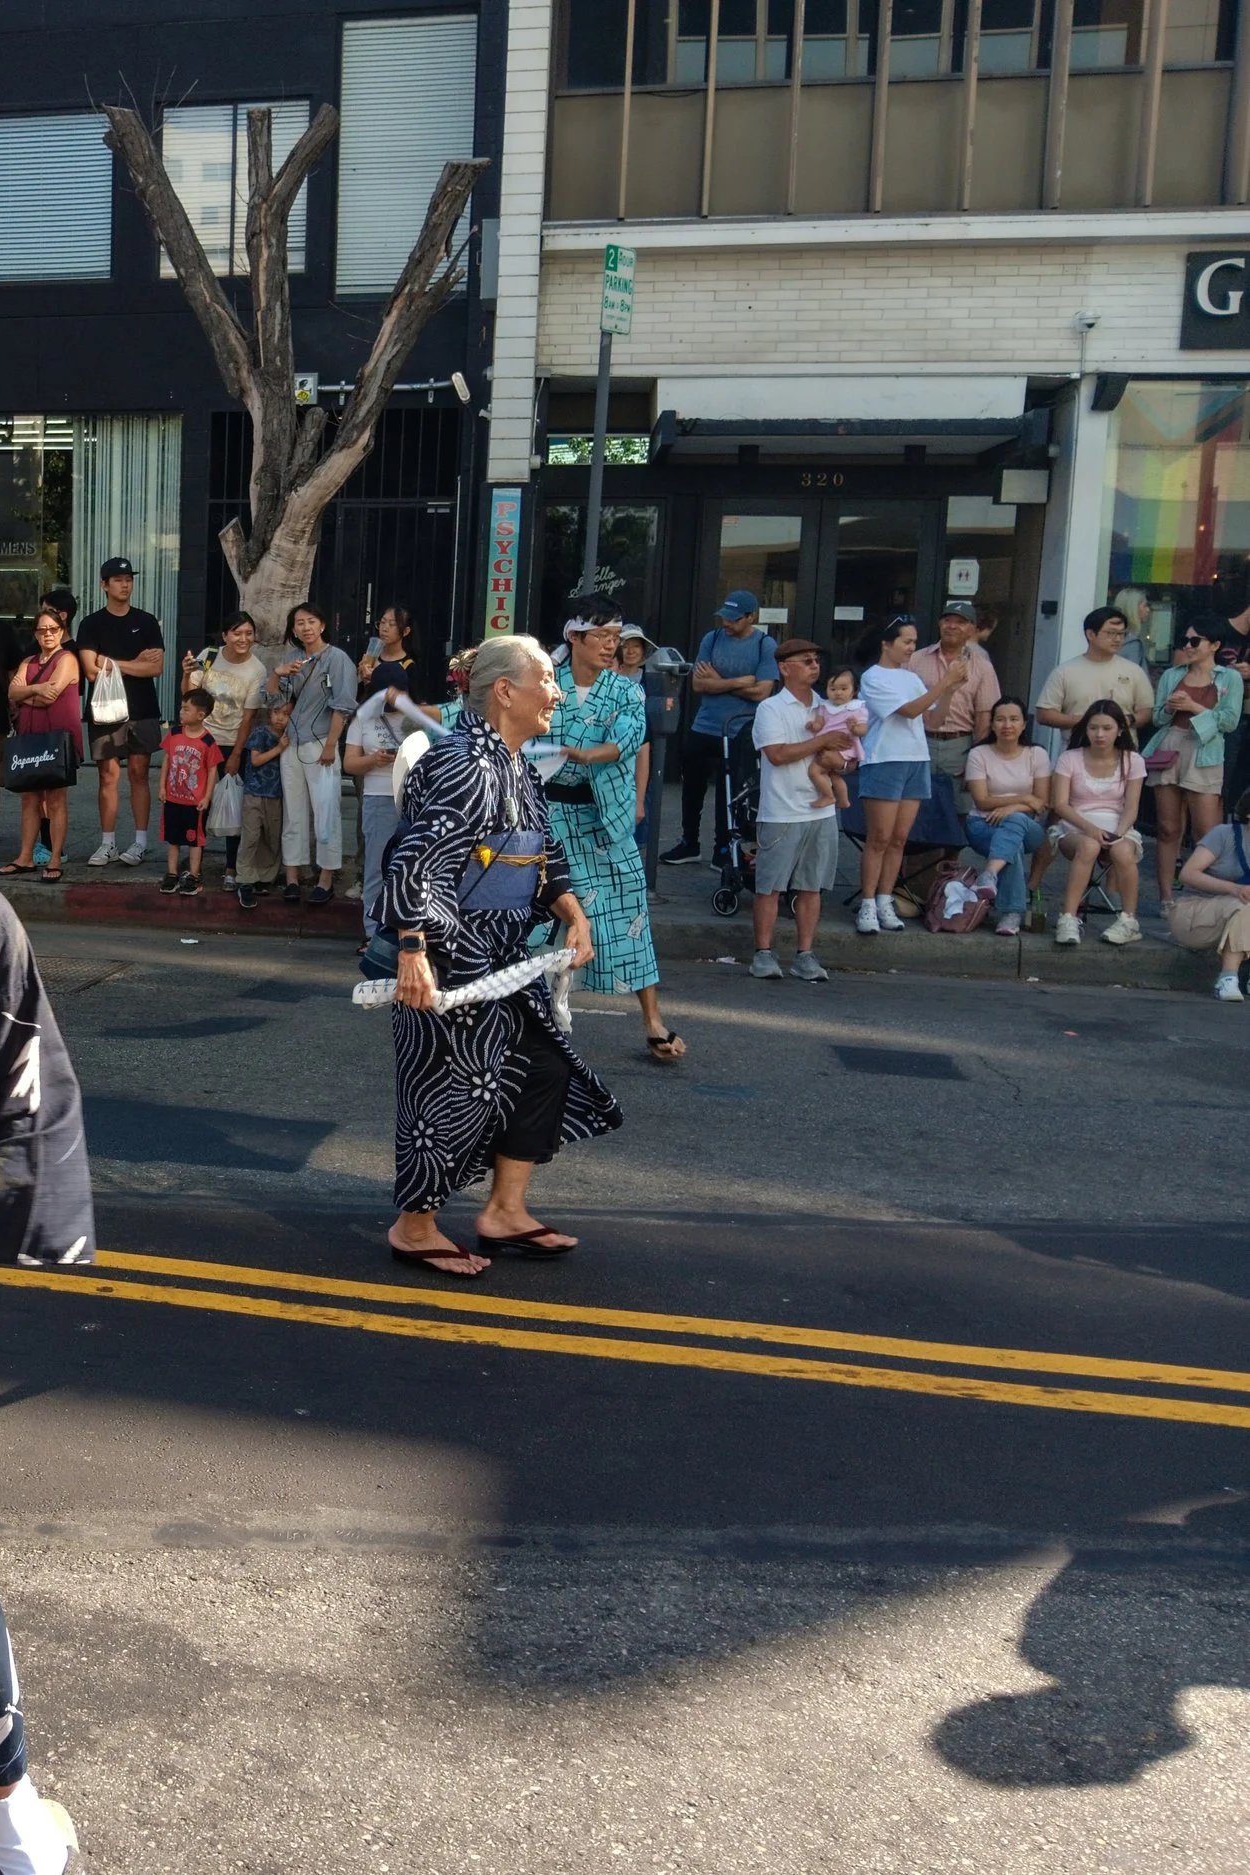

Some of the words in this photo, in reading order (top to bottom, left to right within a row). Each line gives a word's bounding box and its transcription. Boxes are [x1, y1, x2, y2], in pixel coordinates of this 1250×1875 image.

[608, 249, 615, 267] 2
[605, 274, 633, 295] PARKING
[1196, 257, 1246, 316] G
[801, 472, 844, 487] 320
[490, 502, 516, 630] PSYCHIC
[567, 576, 626, 599] Sanger
[10, 750, 55, 771] Japangeles
